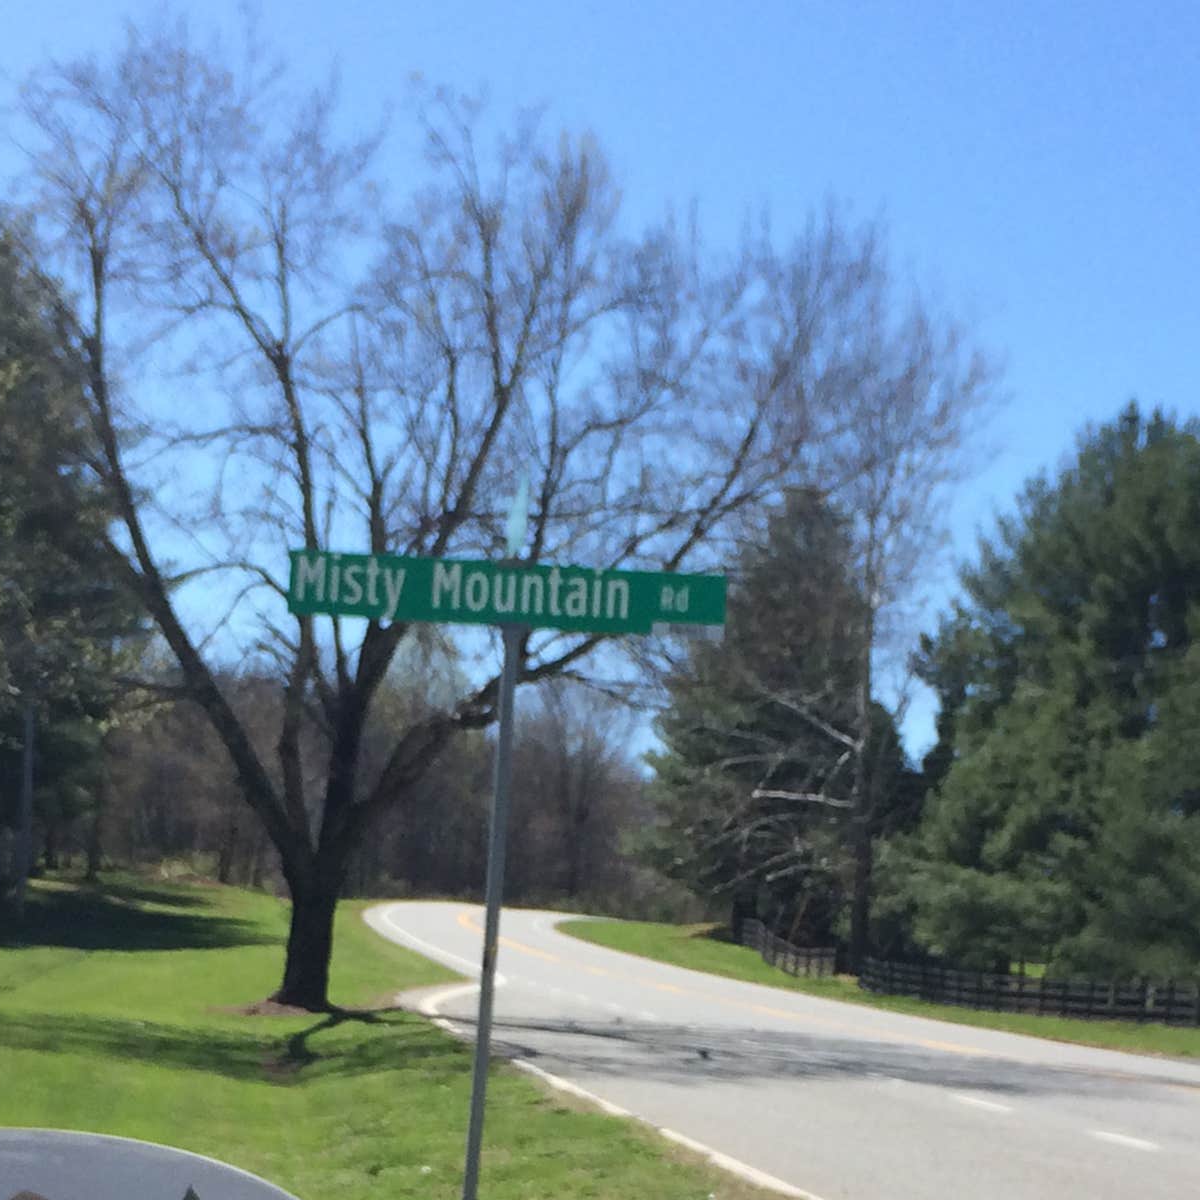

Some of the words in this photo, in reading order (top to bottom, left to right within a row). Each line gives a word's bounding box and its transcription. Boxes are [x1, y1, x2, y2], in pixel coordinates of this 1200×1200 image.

[295, 553, 405, 619] Misty
[431, 562, 630, 619] Mountain
[661, 586, 690, 613] Rd
